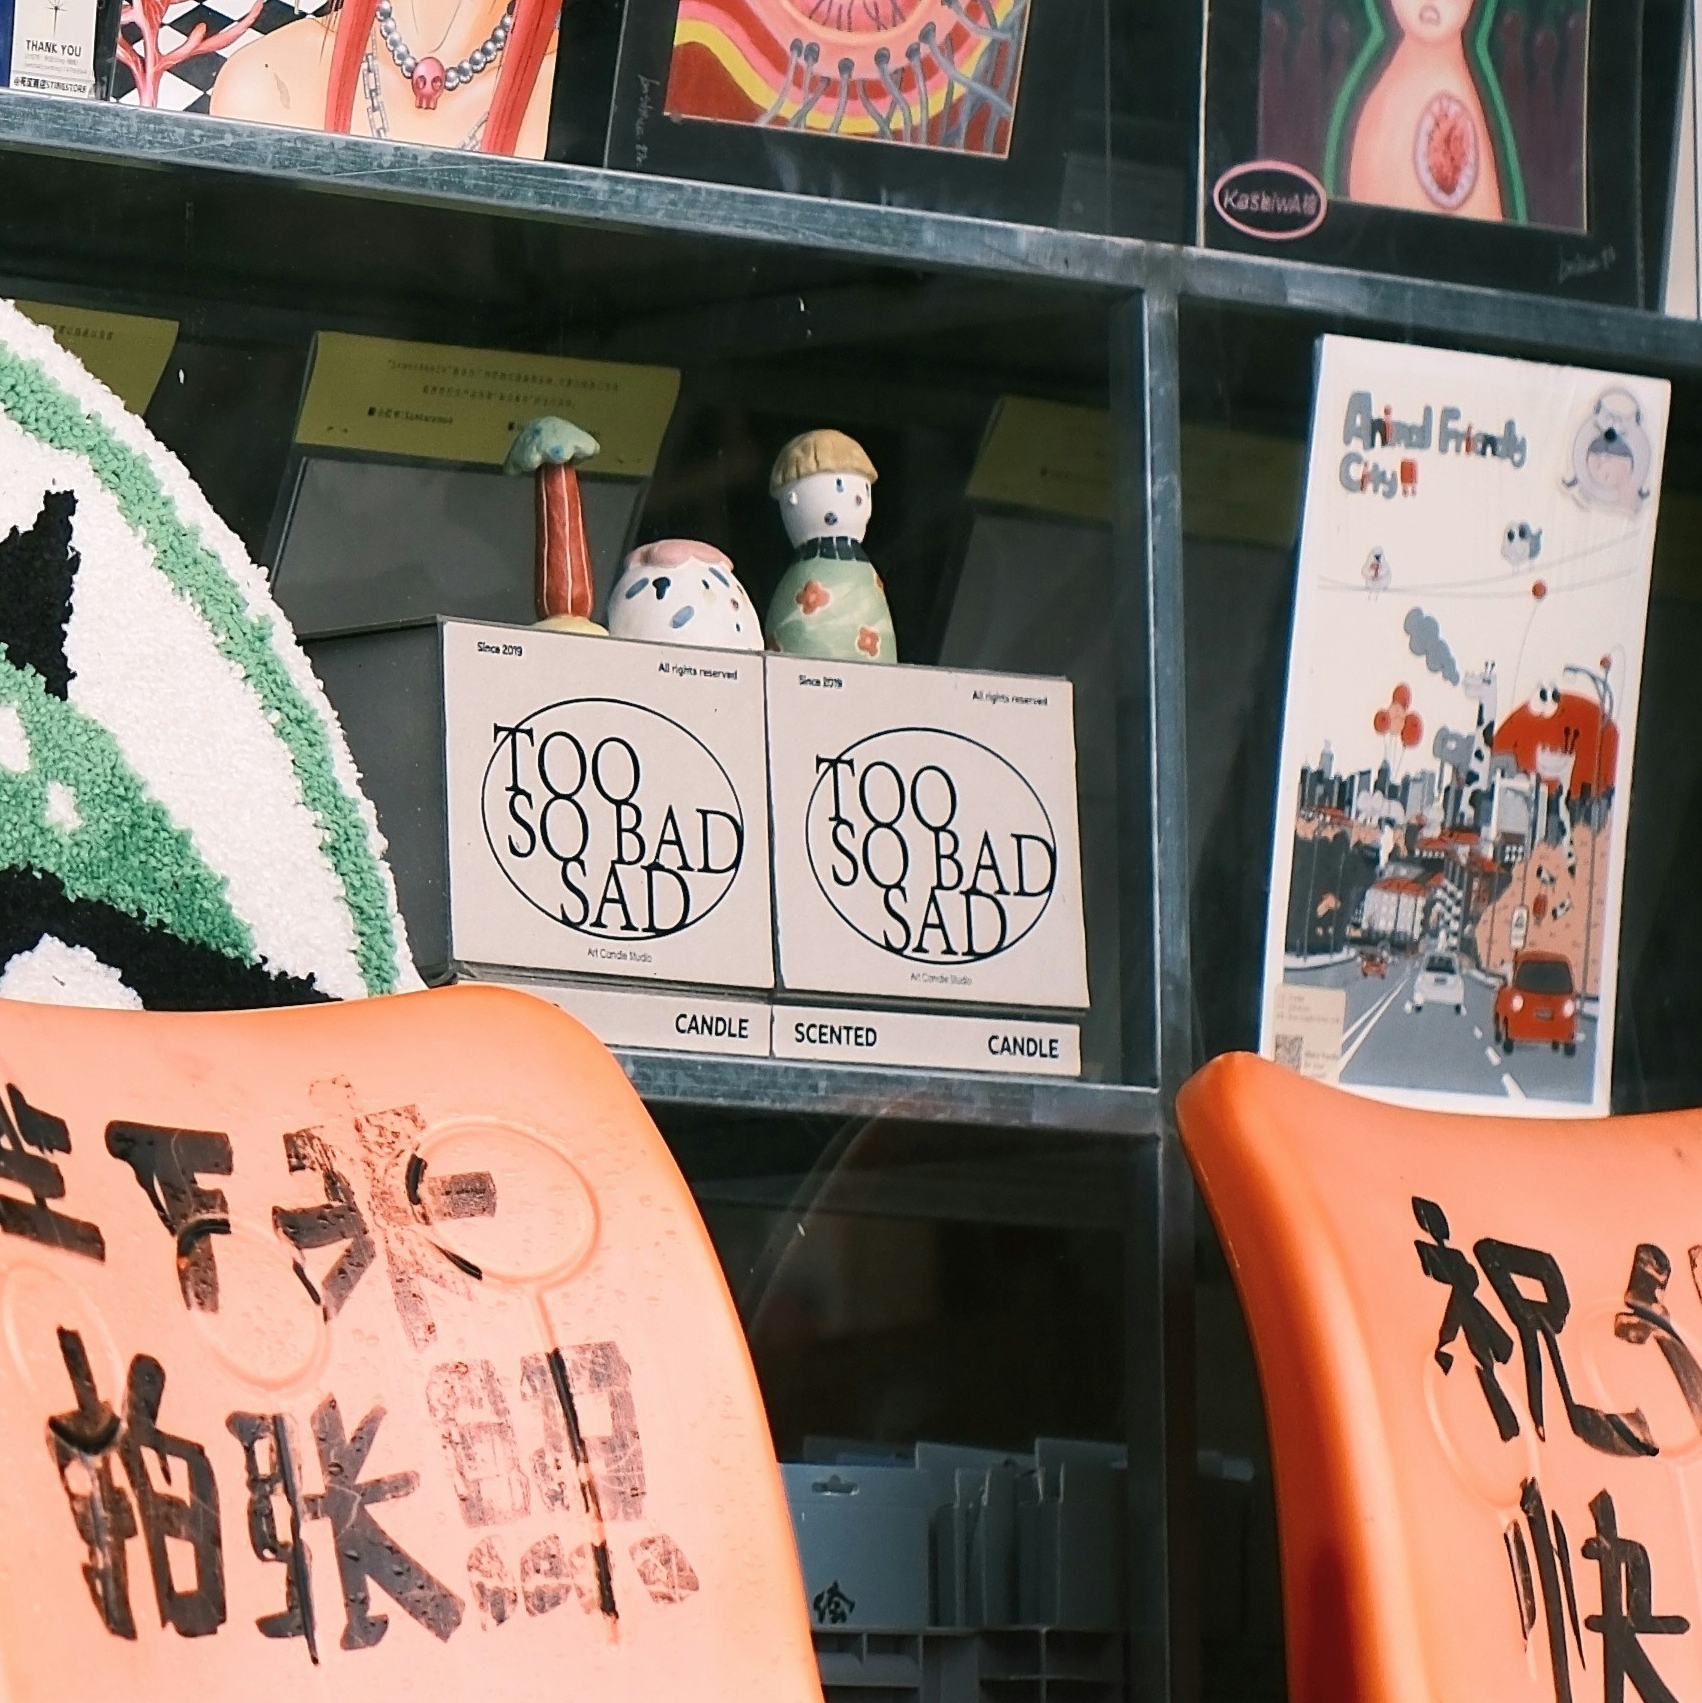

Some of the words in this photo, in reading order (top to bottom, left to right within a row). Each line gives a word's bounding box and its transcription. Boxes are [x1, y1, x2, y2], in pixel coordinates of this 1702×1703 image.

[26, 39, 57, 54] THANK
[61, 44, 82, 57] YOU
[1343, 390, 1433, 452] Animal
[1438, 405, 1527, 468] Friendly
[477, 641, 501, 655] Since
[502, 644, 523, 657] 2019
[658, 662, 671, 674] All
[672, 664, 697, 678] rights
[699, 667, 738, 681] reserved
[798, 674, 821, 687] Since
[493, 723, 640, 804] TOO
[815, 754, 957, 832] TOO
[507, 792, 590, 862] SO
[611, 802, 744, 875] BAD
[831, 821, 909, 888] SO
[931, 829, 1057, 898] BAD
[560, 858, 691, 937] SAD
[883, 885, 1008, 958] SAD
[675, 1013, 749, 1039] CANDLE
[794, 1021, 878, 1047] SCENTED
[987, 1035, 1060, 1059] CANDLE
